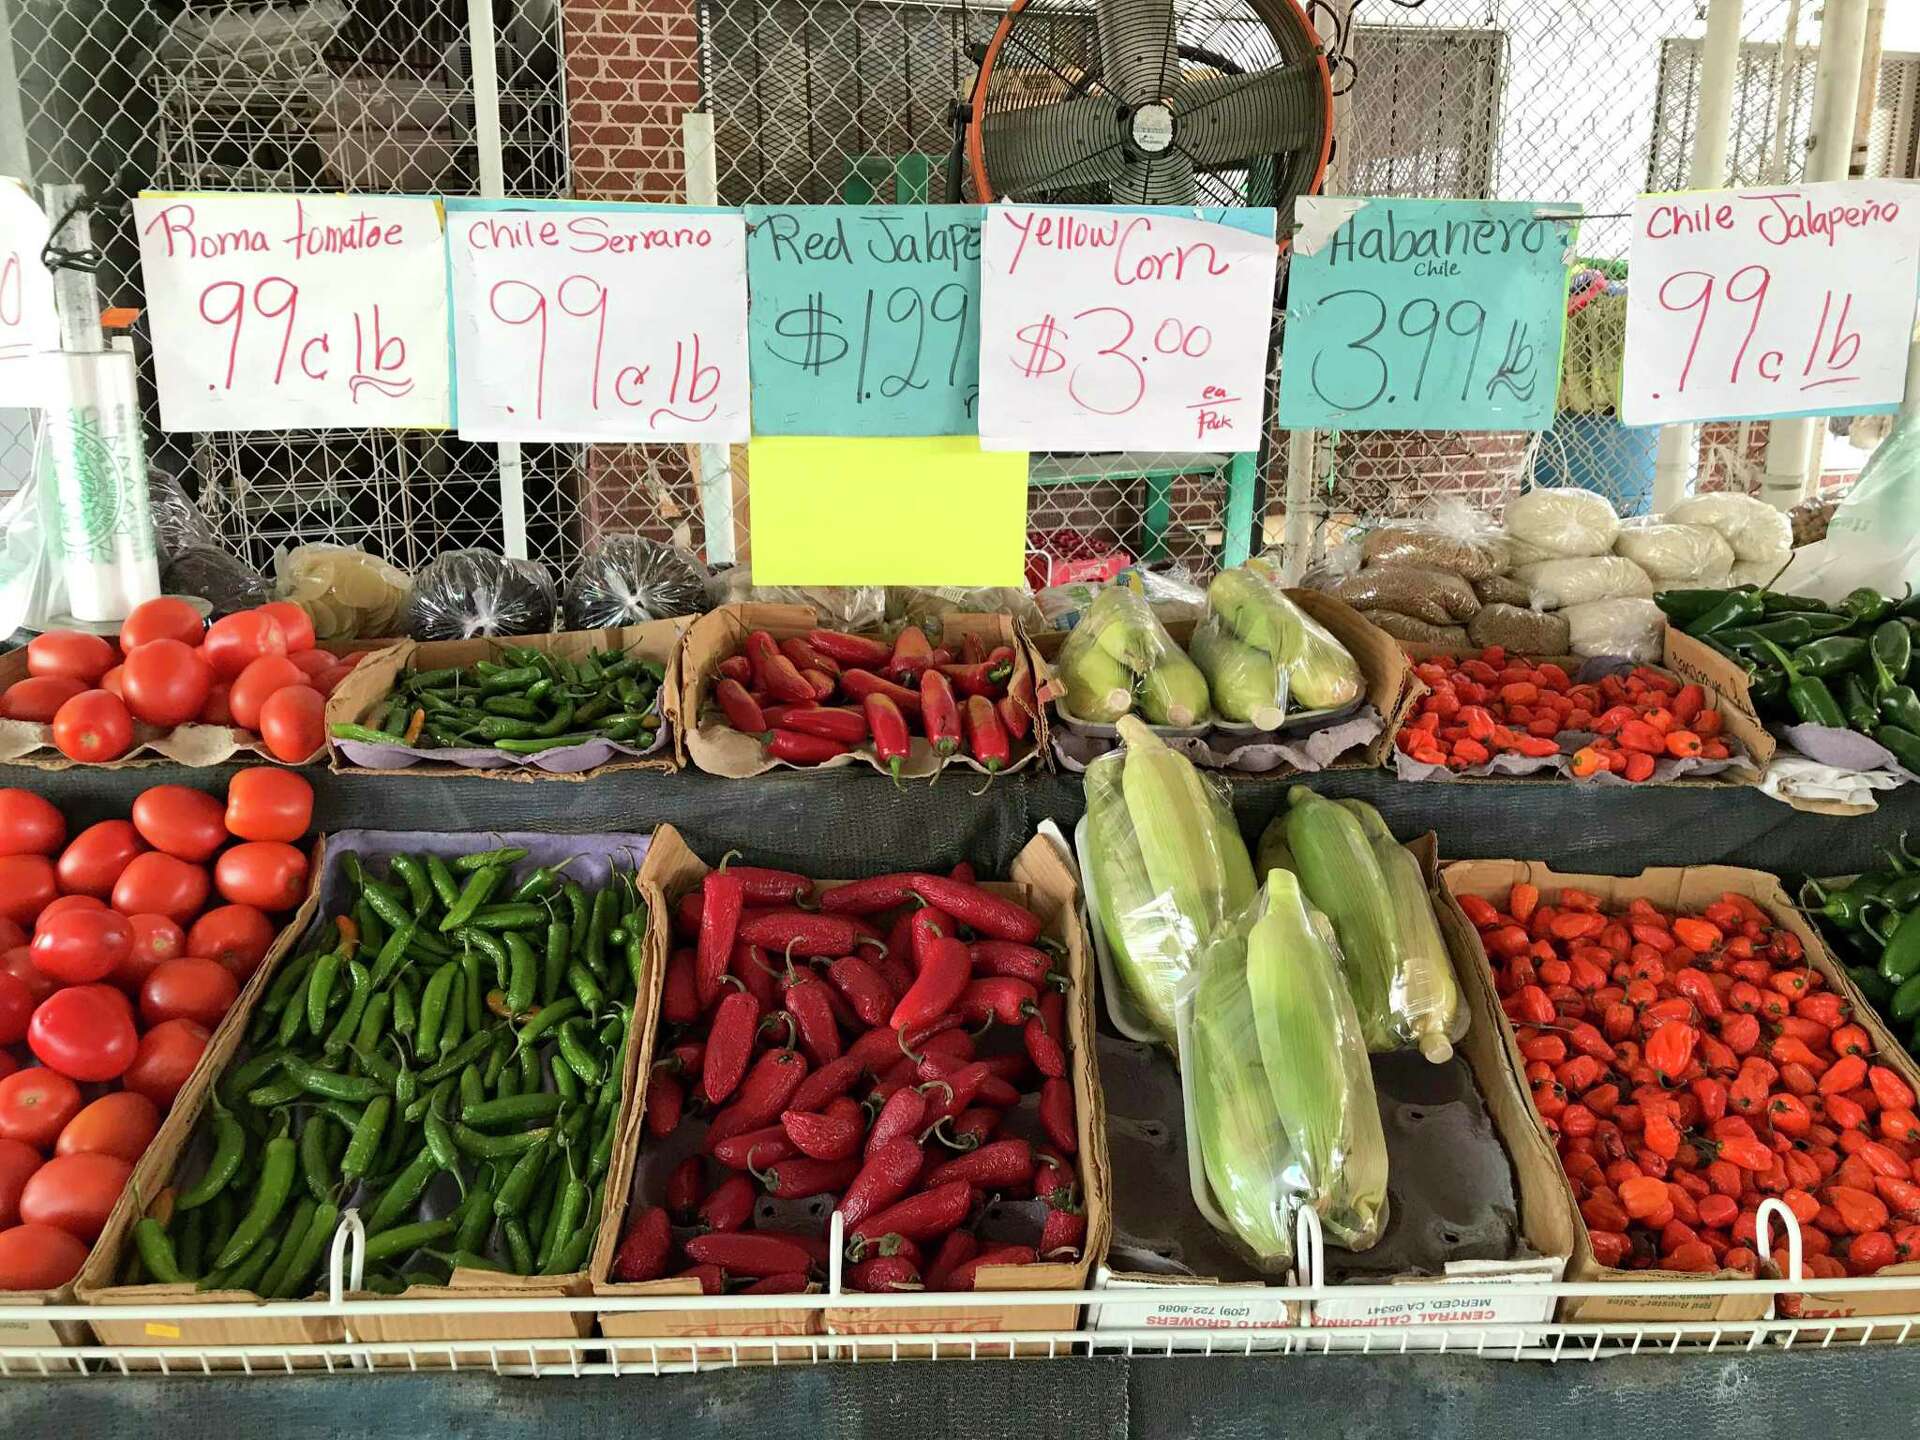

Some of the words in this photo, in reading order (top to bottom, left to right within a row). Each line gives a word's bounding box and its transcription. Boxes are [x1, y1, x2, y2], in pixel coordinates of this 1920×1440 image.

[145, 204, 270, 259] Roma
[285, 199, 403, 260] tomatoe
[468, 214, 560, 250] Chile
[568, 217, 713, 254] Serrano
[750, 213, 853, 265] Red
[866, 211, 982, 272] Jalape
[1329, 209, 1545, 266] Habanero
[1645, 203, 1735, 240] Chile
[1738, 193, 1901, 248] Jalapeño
[1113, 216, 1230, 286] Corn
[764, 283, 970, 405] $1.29
[1008, 307, 1212, 415] $3.00
[1310, 289, 1487, 411] 3.99
[1145, 1315, 1232, 1329] GROWERS
[1219, 1305, 1250, 1317] (209)
[1406, 1303, 1425, 1312] CA
[1418, 1309, 1496, 1323] CENTRAL
[1429, 1298, 1492, 1310] MERCED,
